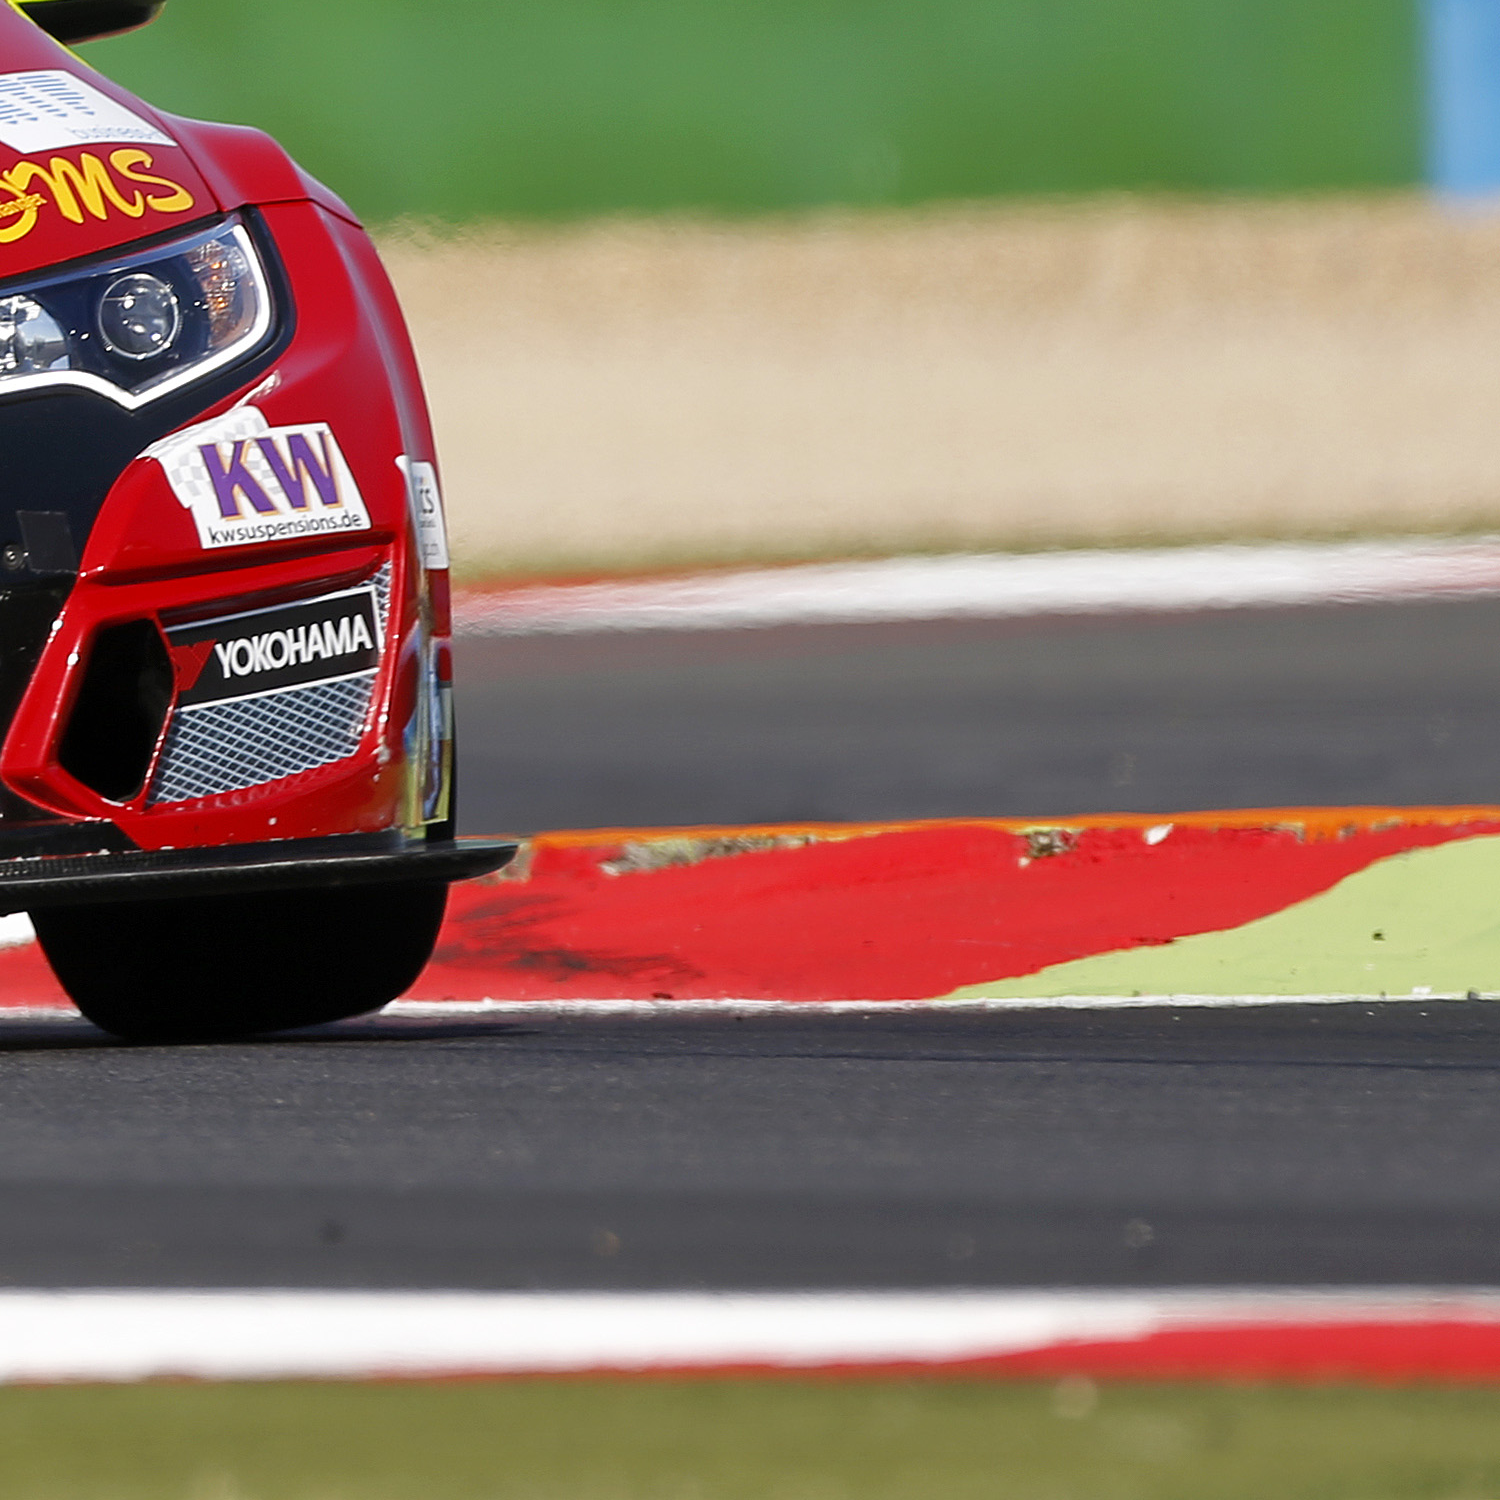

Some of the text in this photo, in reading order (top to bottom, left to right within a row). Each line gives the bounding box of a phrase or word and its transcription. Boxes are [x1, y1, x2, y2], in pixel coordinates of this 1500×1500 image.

[199, 431, 344, 522] KW
[208, 513, 362, 545] kwsuspensions.de
[215, 614, 373, 679] YOKOHAMA
